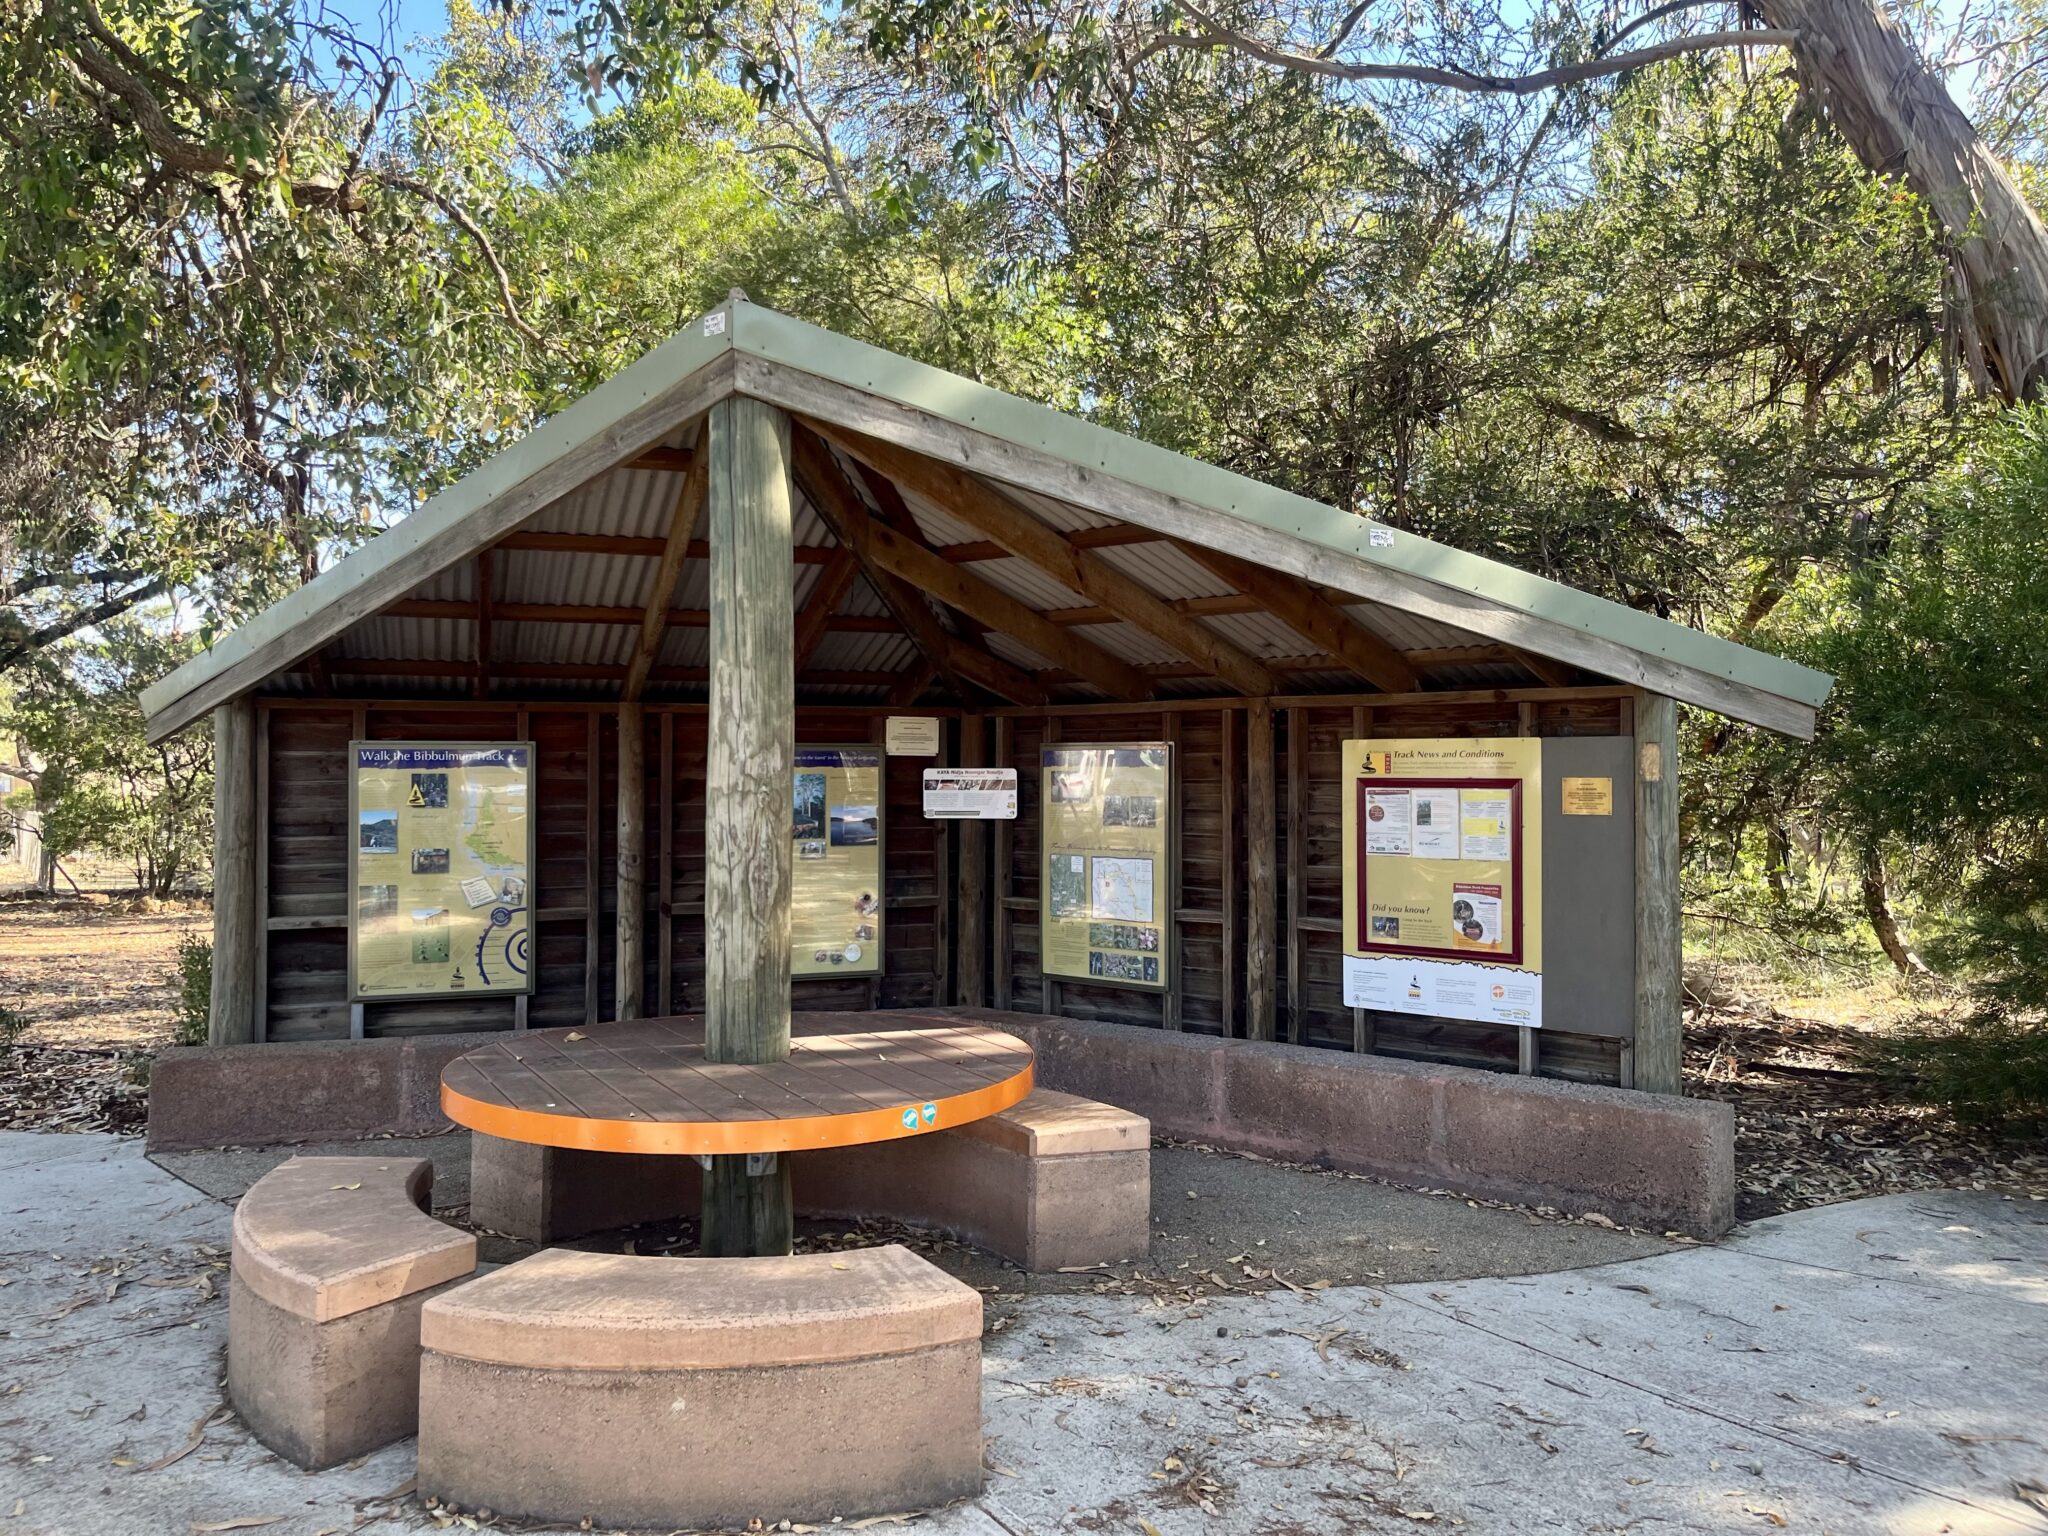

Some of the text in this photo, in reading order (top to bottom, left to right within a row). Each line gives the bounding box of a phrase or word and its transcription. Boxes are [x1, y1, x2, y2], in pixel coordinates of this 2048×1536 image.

[361, 751, 390, 761] Walk
[393, 751, 411, 761] the
[1394, 750, 1415, 758] Track
[1441, 750, 1457, 758] and
[1459, 749, 1504, 758] Conditions
[1372, 903, 1430, 915] Did you know?
